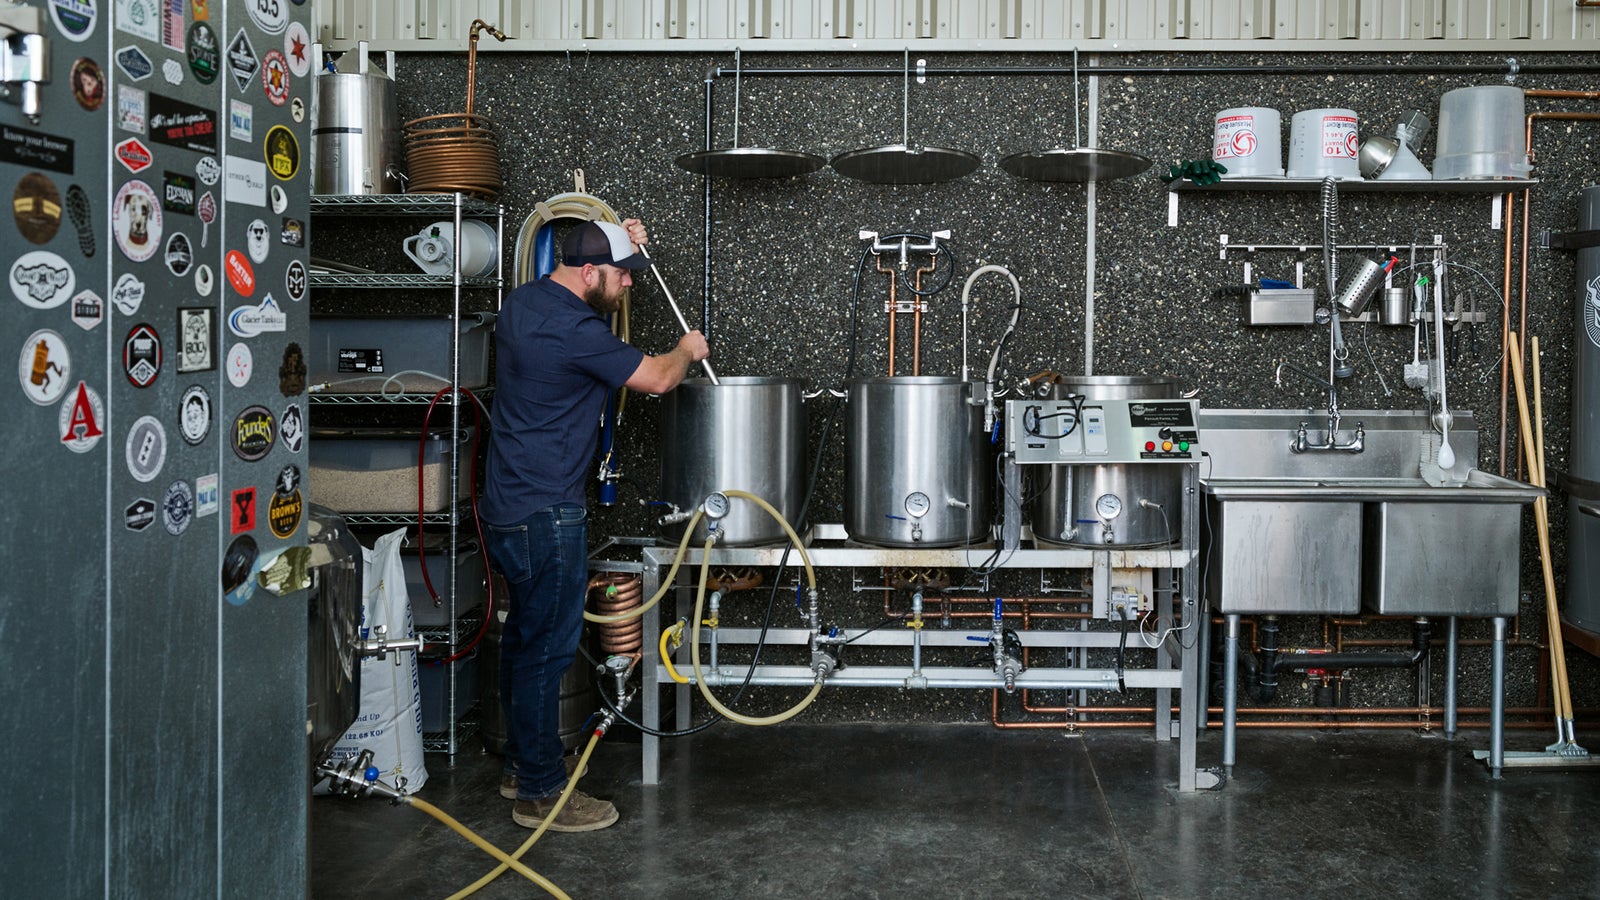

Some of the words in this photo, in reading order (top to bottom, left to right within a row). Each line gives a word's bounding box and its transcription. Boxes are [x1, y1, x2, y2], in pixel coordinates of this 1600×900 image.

[3, 127, 24, 141] know
[25, 133, 42, 147] your
[1216, 147, 1228, 157] 10
[1326, 147, 1341, 155] 10
[166, 184, 193, 204] ELYSIAN
[62, 381, 103, 442] A
[238, 416, 272, 446] Founders
[271, 502, 300, 519] BROWN'S
[369, 713, 380, 721] Up
